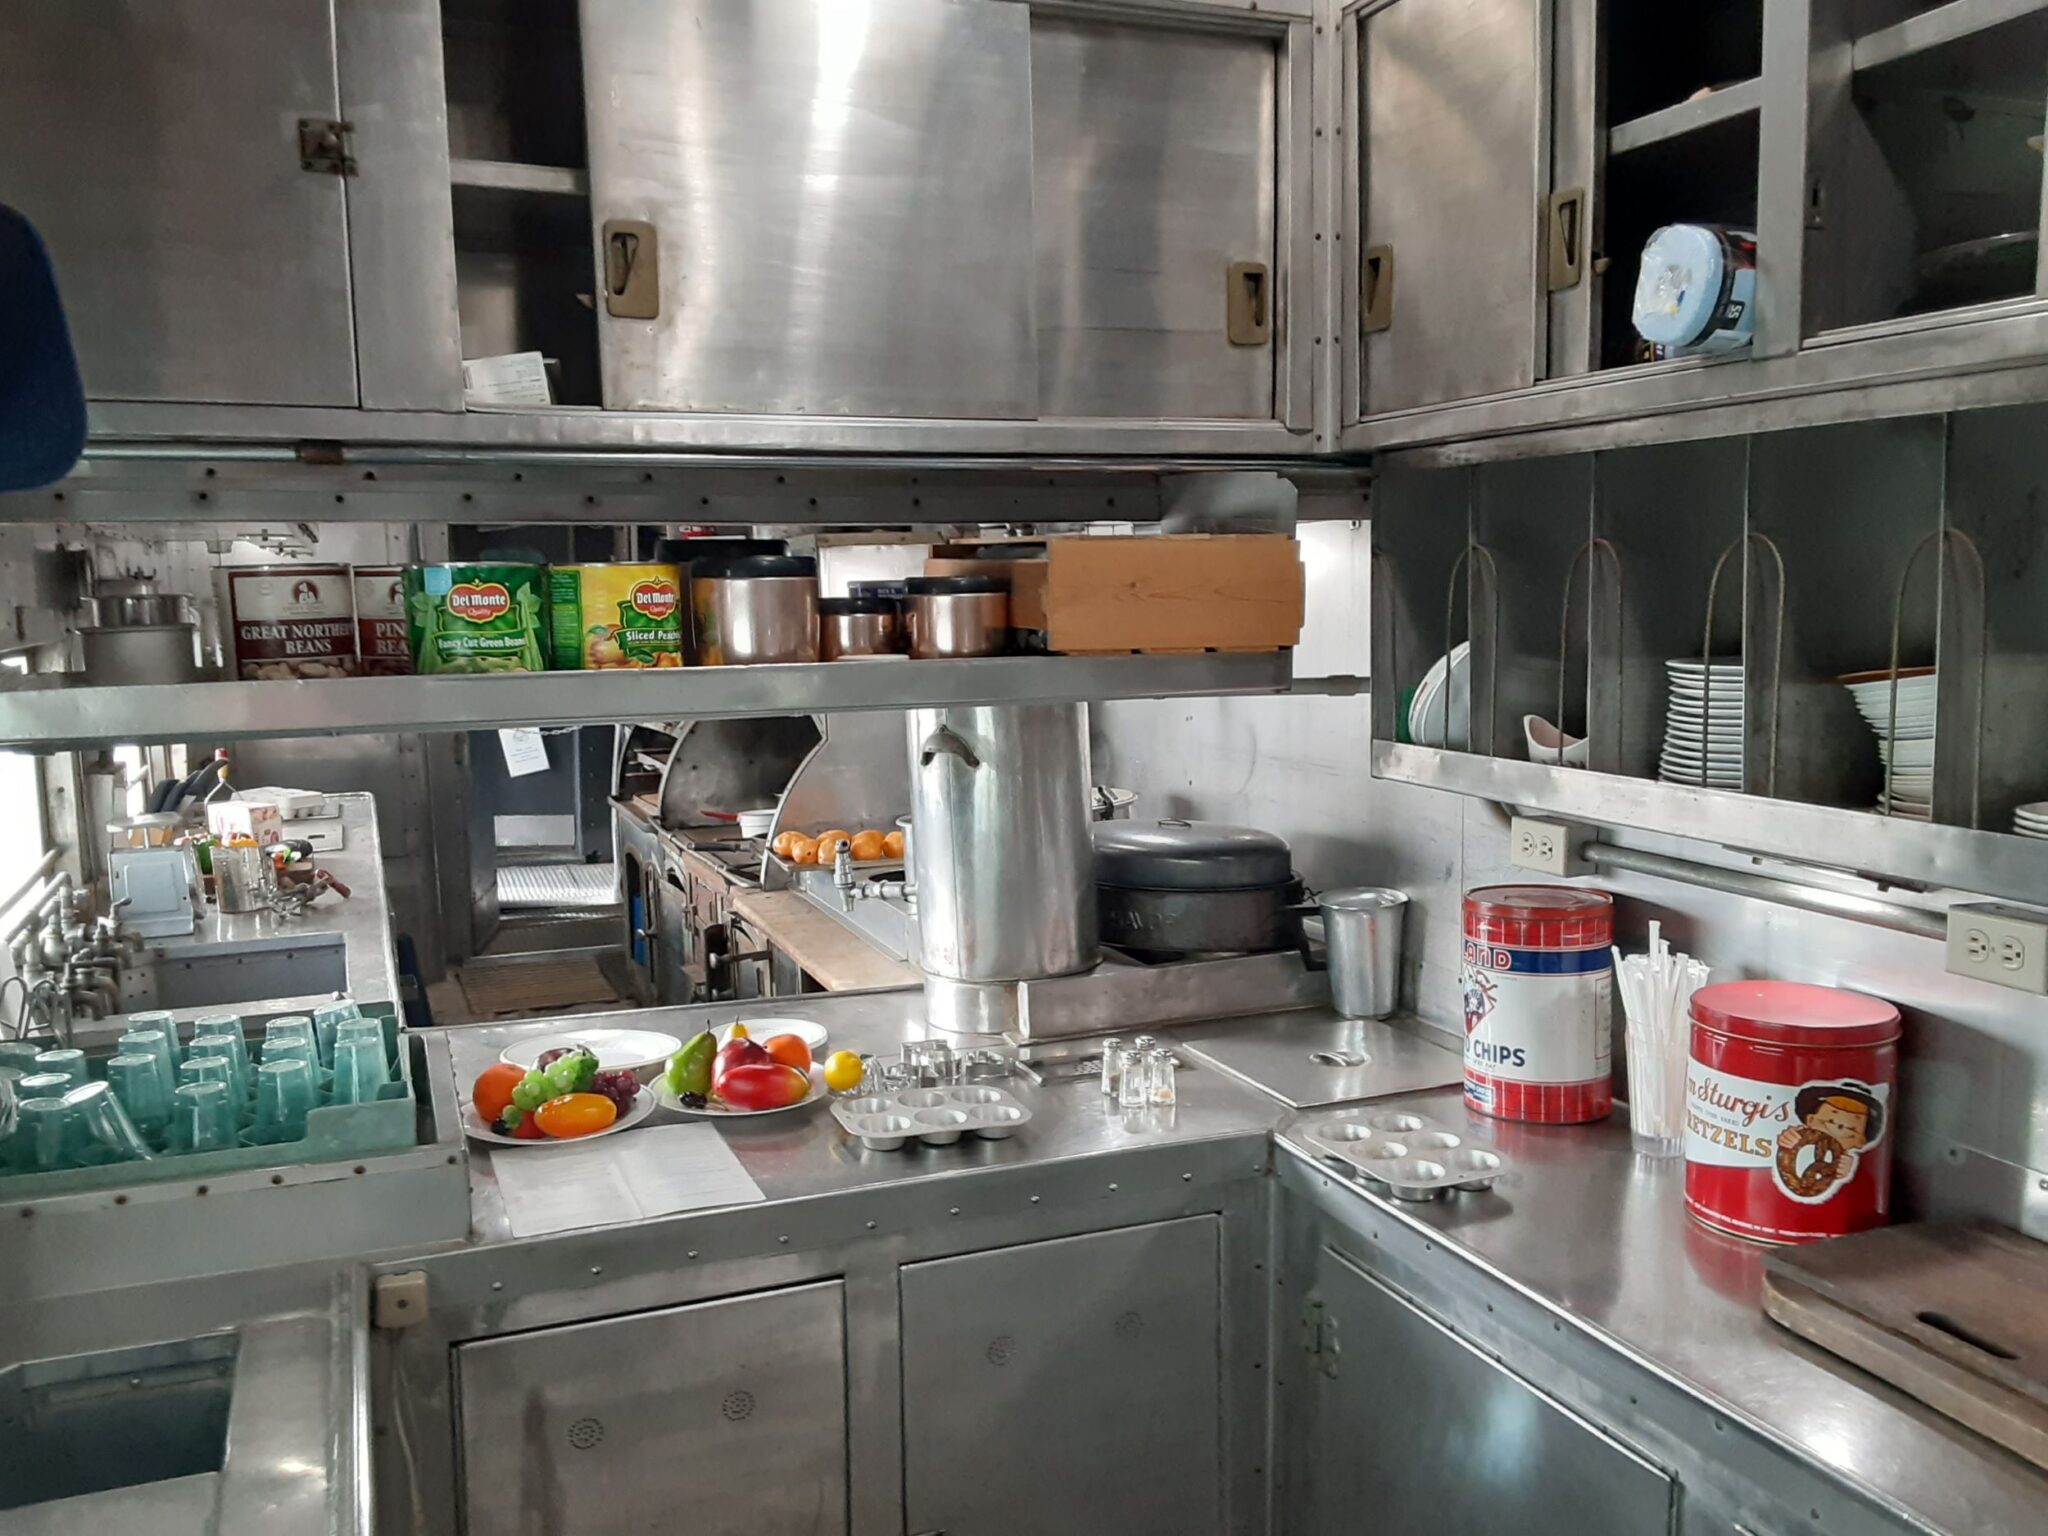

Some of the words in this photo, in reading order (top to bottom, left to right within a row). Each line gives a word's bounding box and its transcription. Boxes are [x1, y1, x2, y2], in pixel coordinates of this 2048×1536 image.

[452, 594, 469, 606] Del
[471, 594, 506, 606] Monte
[636, 592, 651, 604] Del
[241, 624, 288, 640] GREAT
[626, 630, 655, 641] Sliced
[285, 638, 332, 655] BEANS
[463, 636, 478, 649] Cut
[479, 636, 504, 648] Green
[1473, 1039, 1526, 1067] CHIPS
[1698, 1077, 1790, 1127] Sturgis
